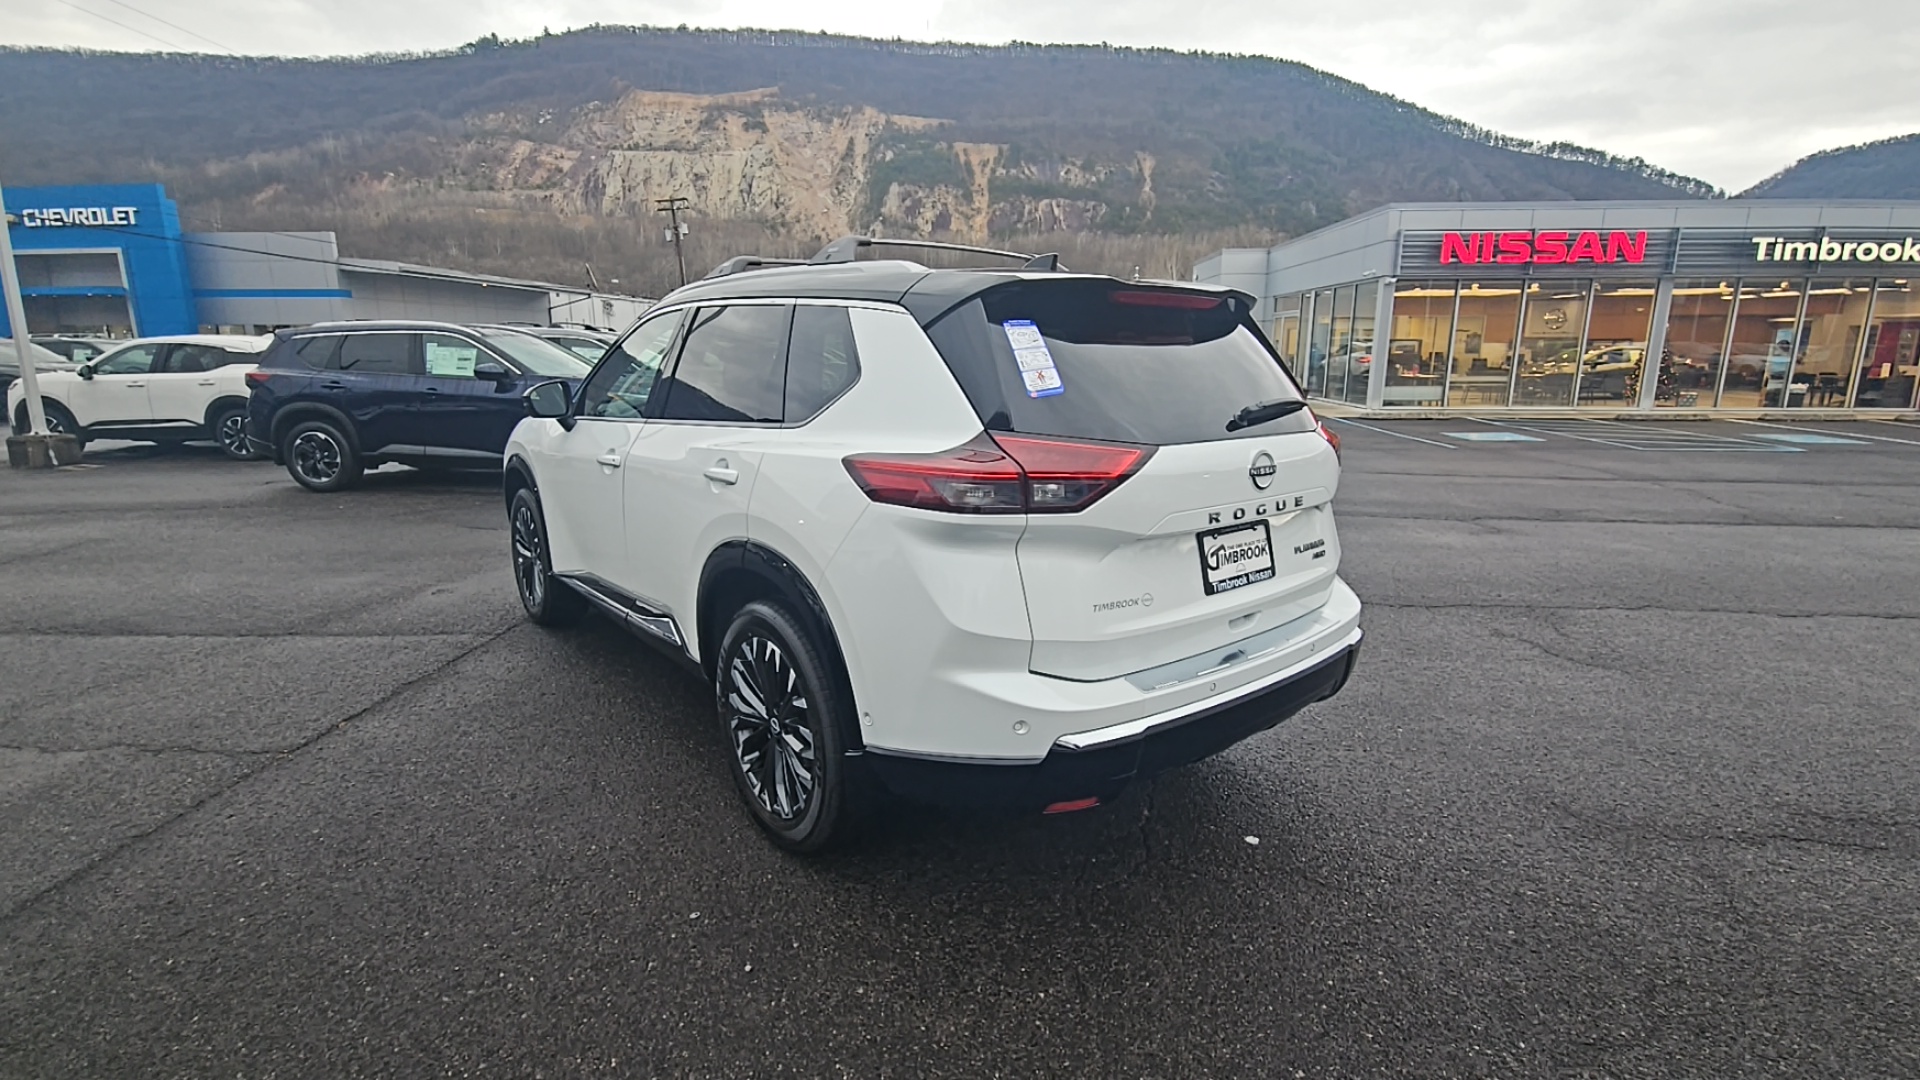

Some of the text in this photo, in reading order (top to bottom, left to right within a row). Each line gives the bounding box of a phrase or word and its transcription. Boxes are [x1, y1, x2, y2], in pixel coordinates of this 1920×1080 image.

[22, 207, 138, 227] CHEVROLET
[1440, 230, 1648, 265] NISSAN
[1751, 236, 1920, 262] Timbrook
[1208, 496, 1304, 525] ROGUE
[1205, 543, 1269, 571] TIMBROOK
[1212, 570, 1273, 593] Timbrook Nissan
[1093, 597, 1140, 613] TIMBROOK
